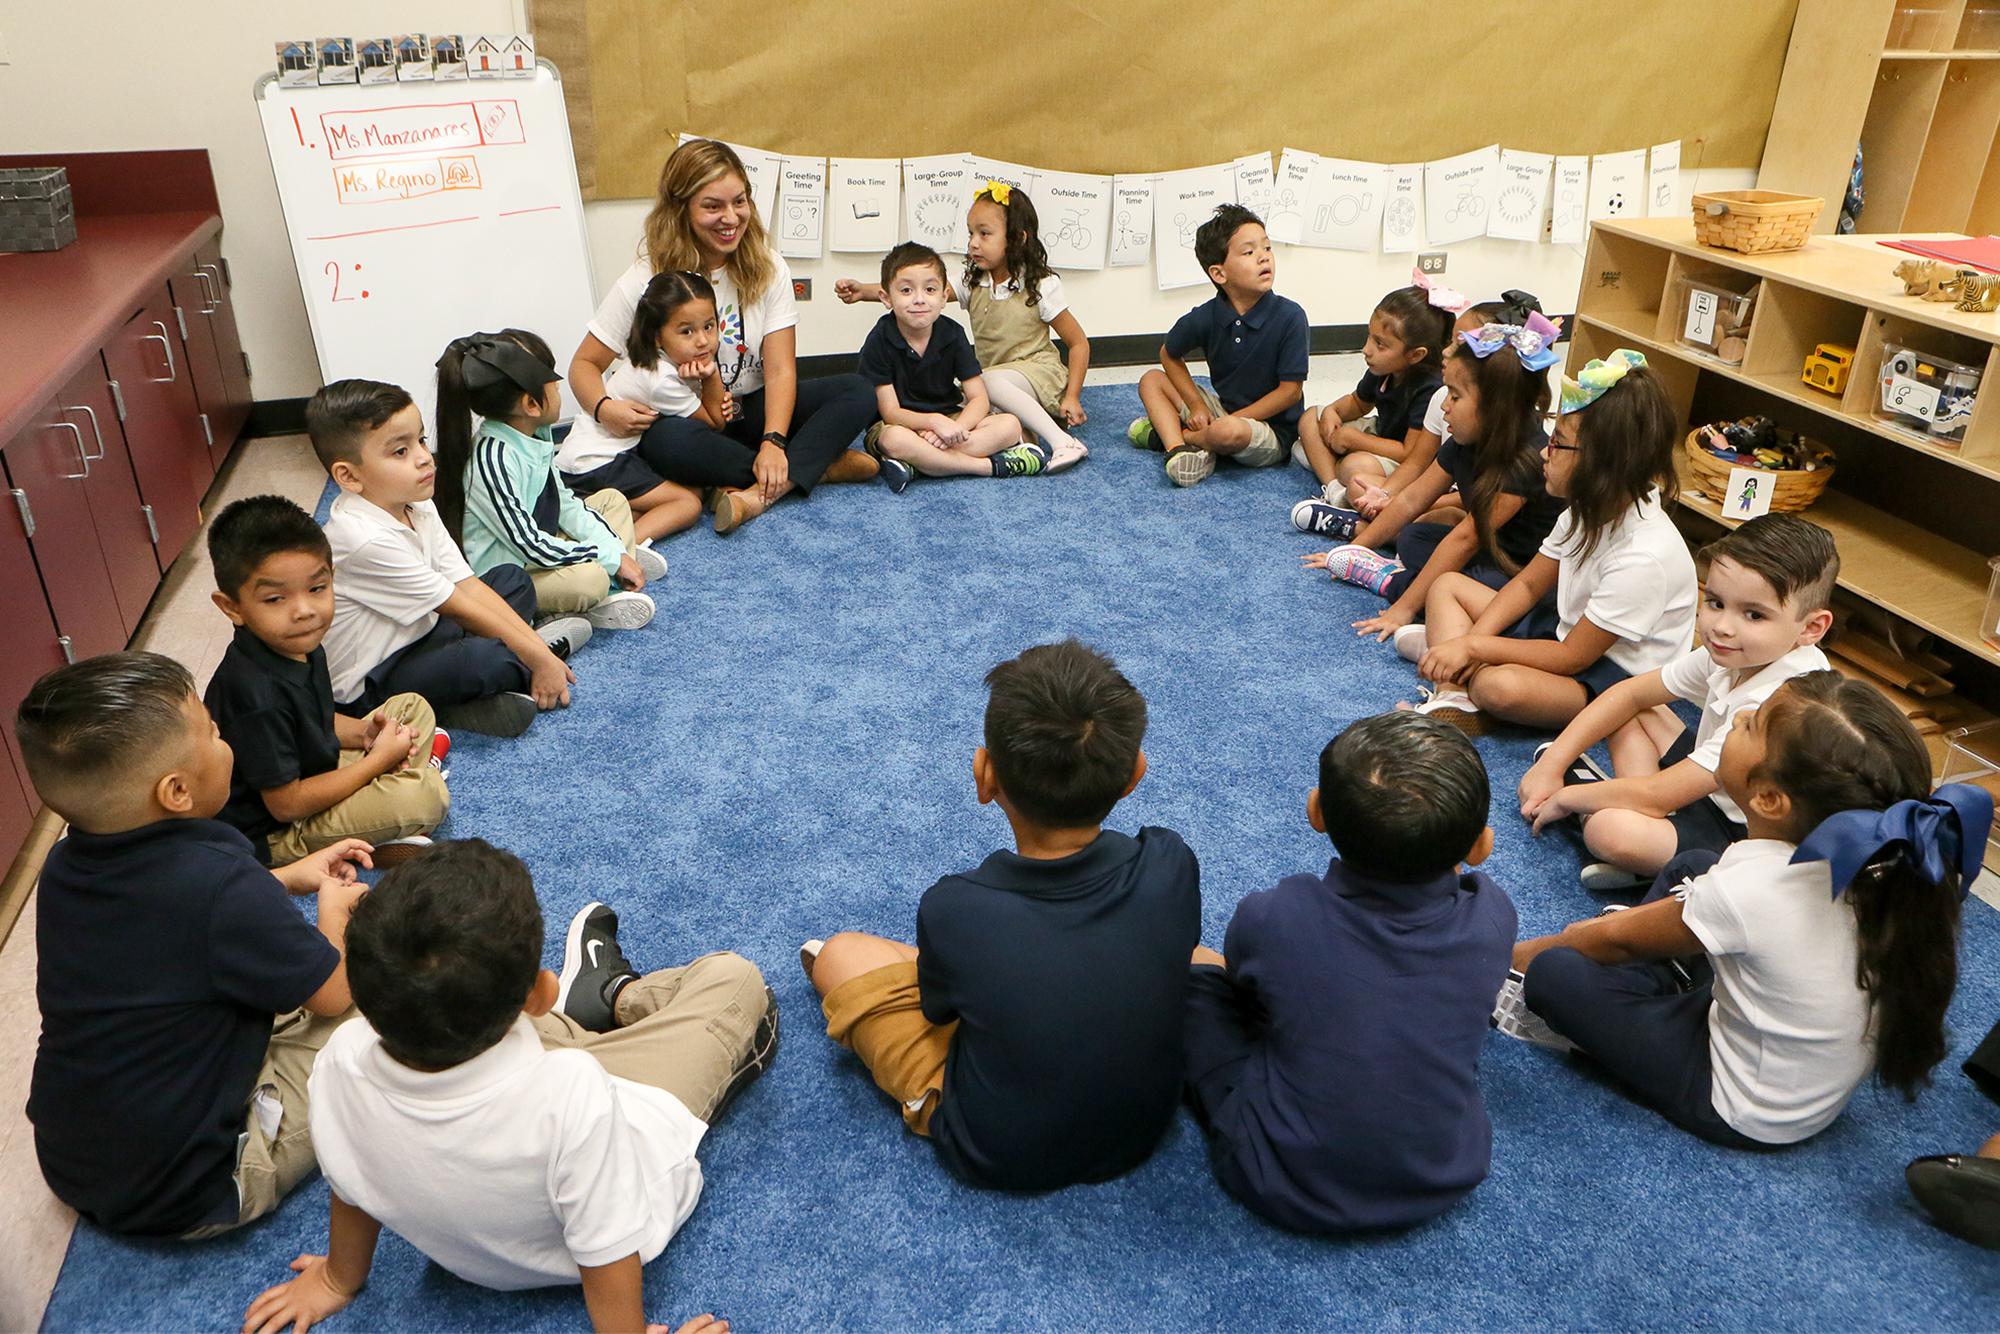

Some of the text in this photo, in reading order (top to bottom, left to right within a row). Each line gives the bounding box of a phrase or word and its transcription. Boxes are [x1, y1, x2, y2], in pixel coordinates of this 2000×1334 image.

[364, 120, 473, 147] Manzanares
[742, 161, 758, 173] ime
[1288, 163, 1308, 174] Recall
[785, 171, 821, 182] Greeting
[1240, 167, 1269, 179] Cleanup
[1288, 172, 1304, 181] Time
[1332, 173, 1368, 184] Lunch Time
[1444, 165, 1484, 181] Outside Time
[1517, 173, 1530, 181] Time
[1563, 169, 1581, 177] Snack
[376, 169, 436, 199] Regino
[847, 178, 886, 186] Book Time
[930, 179, 948, 188] Time
[1247, 177, 1264, 185] Time
[1612, 175, 1625, 183] Gym
[793, 181, 813, 189] Time
[1051, 188, 1098, 199] Outside Time
[1119, 189, 1150, 198] Planning
[1179, 189, 1215, 200] Work Time
